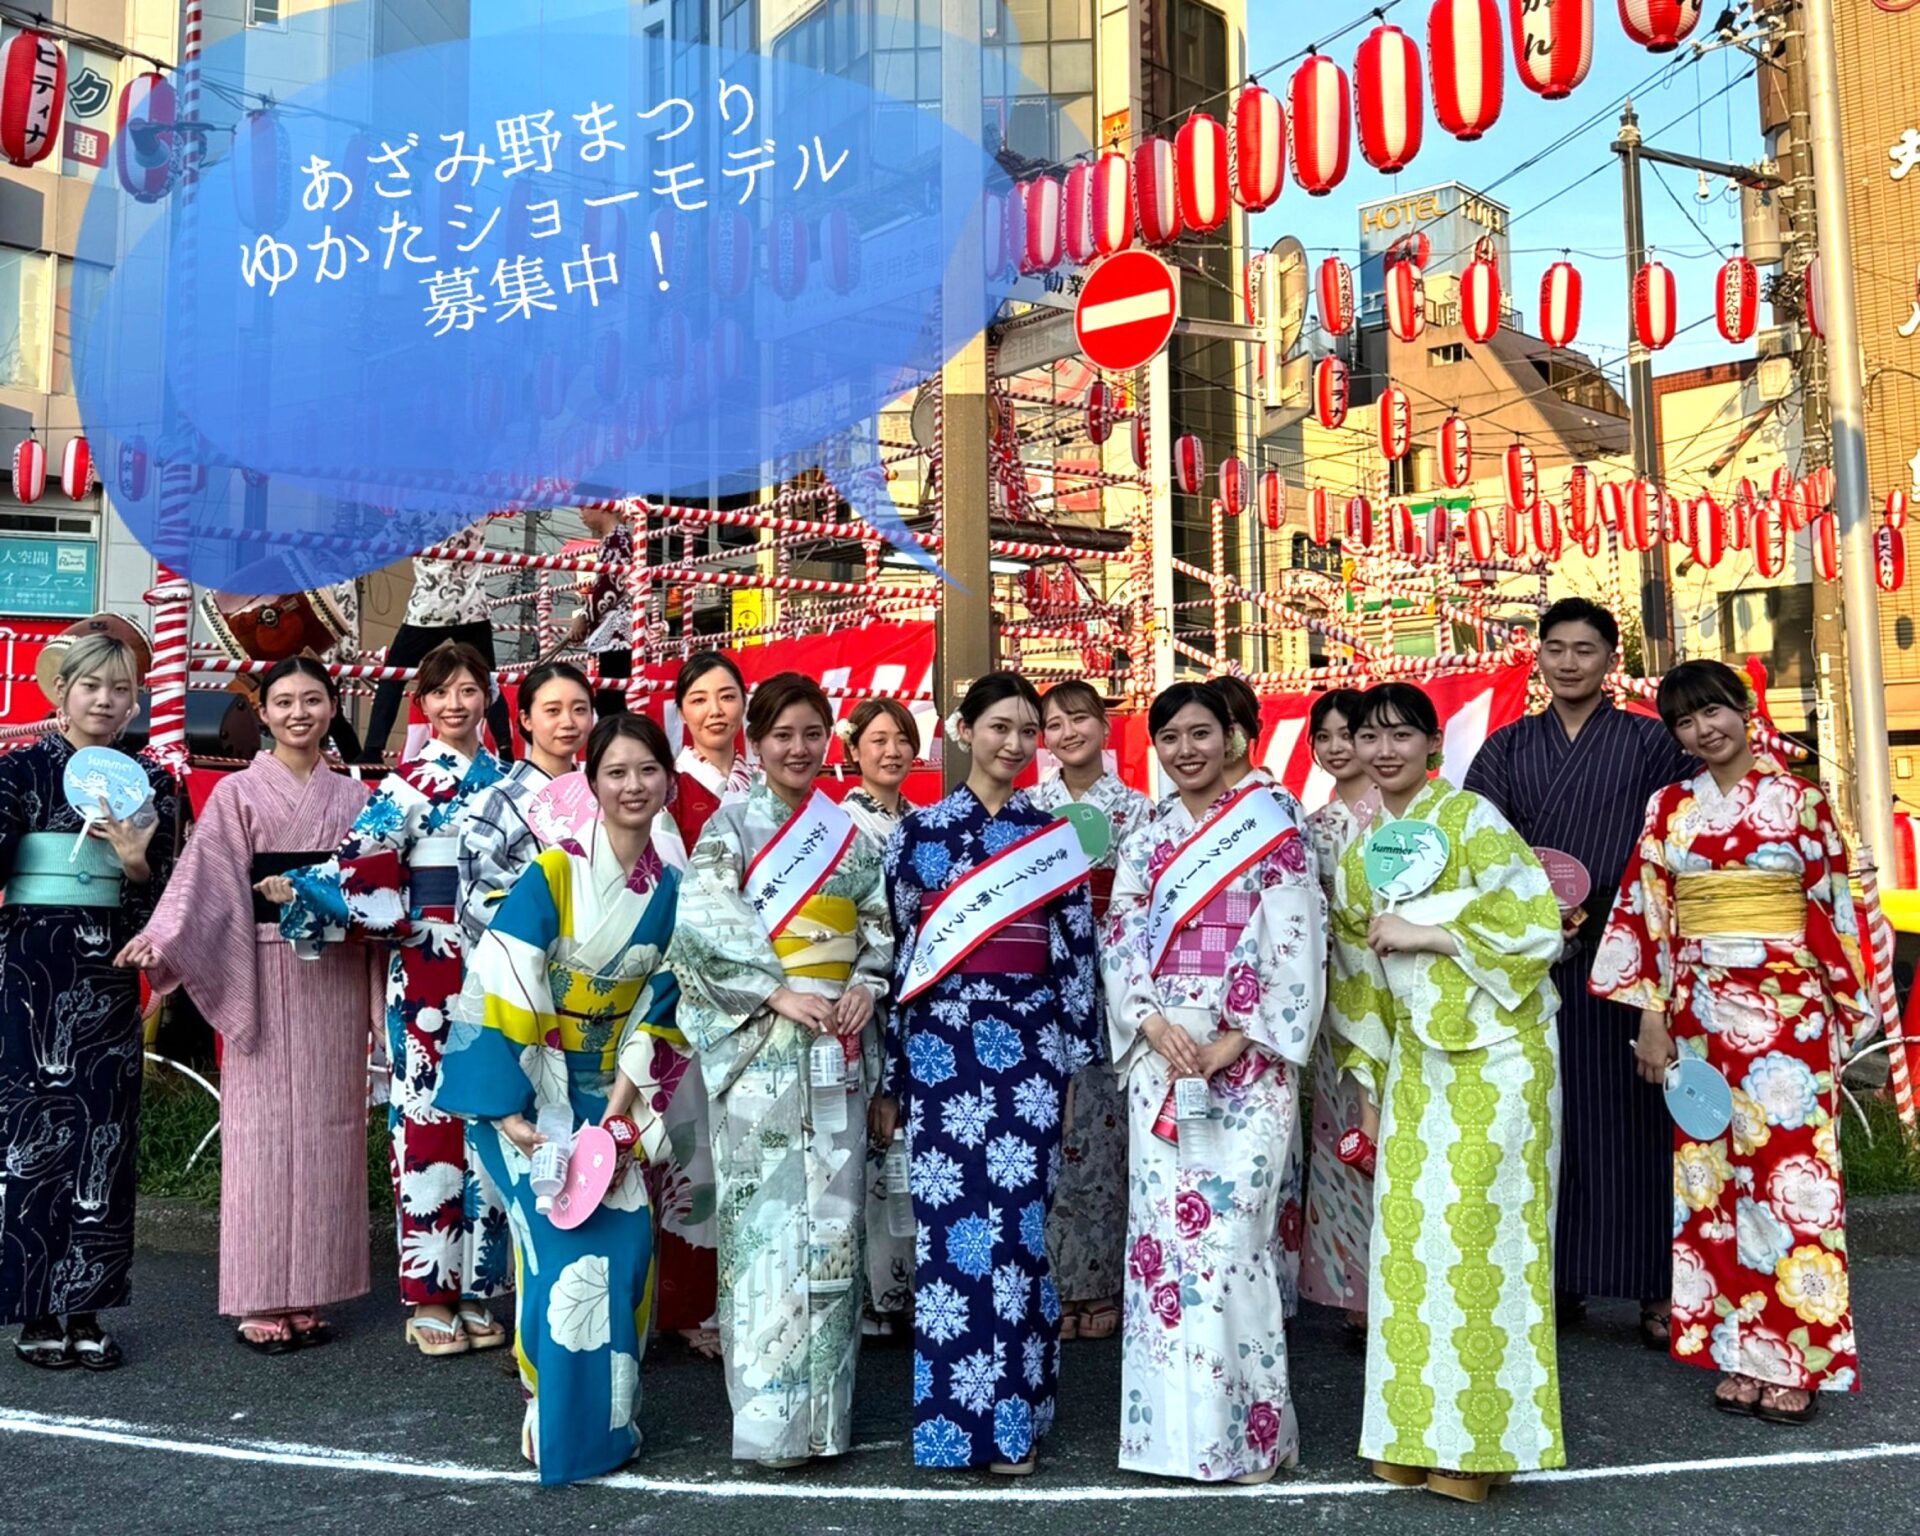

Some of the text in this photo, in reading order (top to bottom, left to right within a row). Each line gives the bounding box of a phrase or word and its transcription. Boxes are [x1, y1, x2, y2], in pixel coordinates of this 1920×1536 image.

[1362, 194, 1447, 235] HOTEL
[1371, 842, 1413, 855] Summer
[1147, 817, 1258, 951] きものクイーン準グラン
